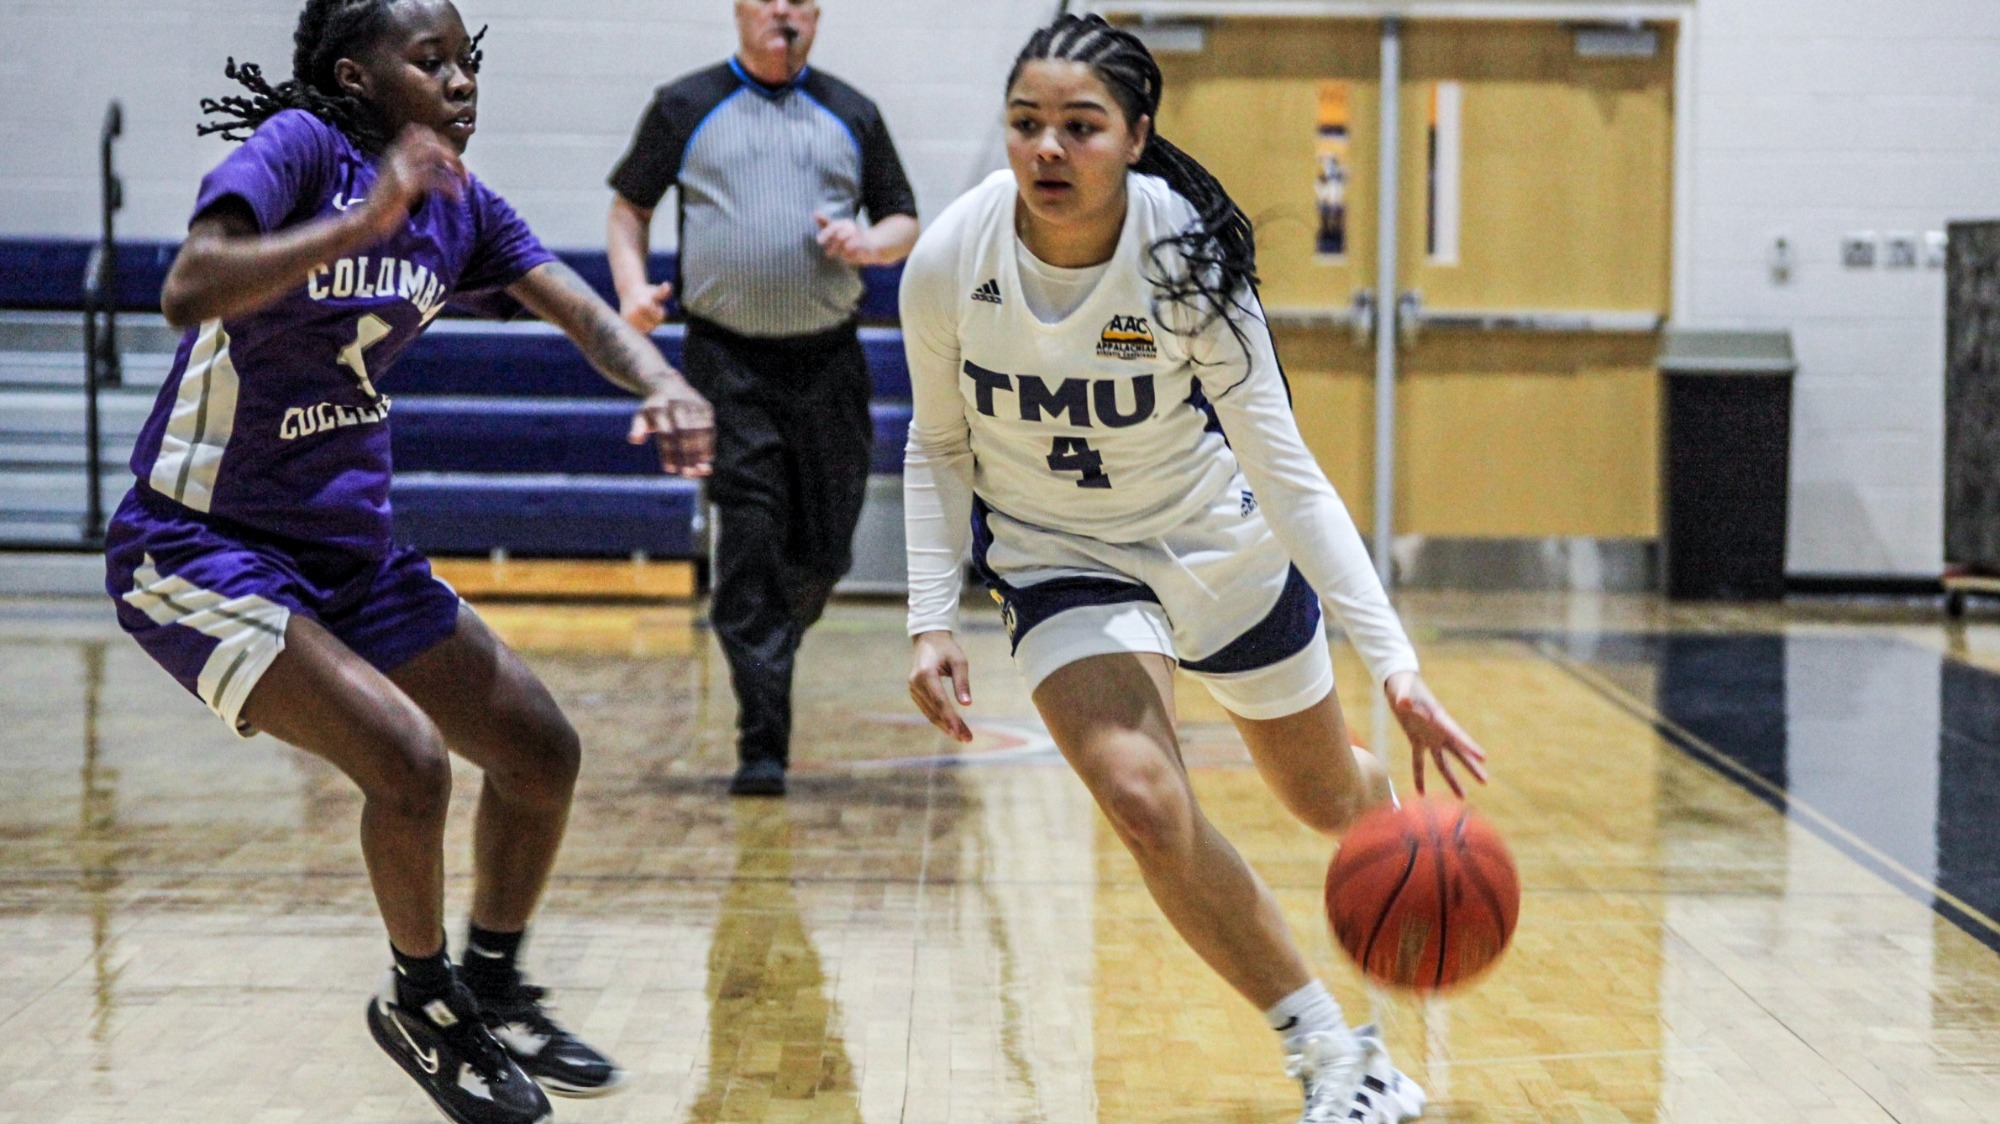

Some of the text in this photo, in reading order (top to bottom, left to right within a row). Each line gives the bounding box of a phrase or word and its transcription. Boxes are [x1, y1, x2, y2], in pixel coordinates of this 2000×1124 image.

[1096, 341, 1158, 354] APPALACHIAN
[1110, 314, 1148, 334] AAC
[337, 312, 393, 398] 1
[963, 359, 1155, 428] TMU
[1046, 436, 1112, 489] 4
